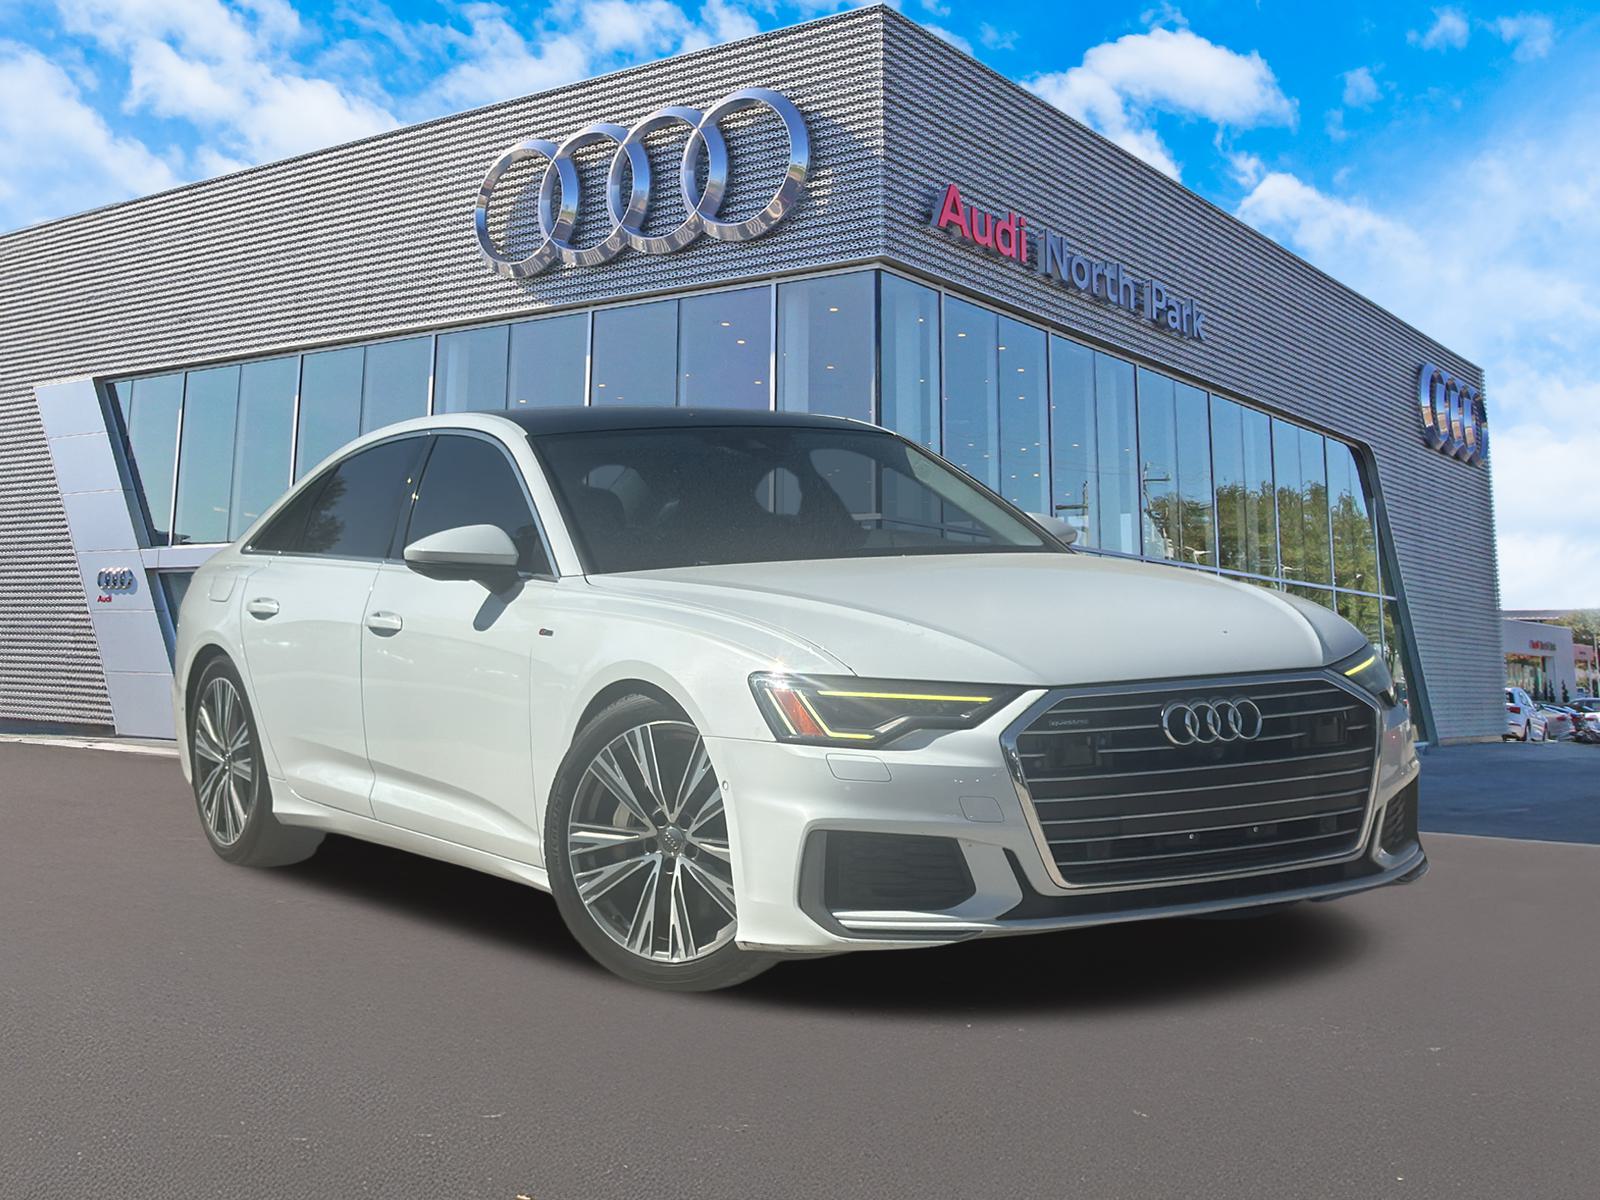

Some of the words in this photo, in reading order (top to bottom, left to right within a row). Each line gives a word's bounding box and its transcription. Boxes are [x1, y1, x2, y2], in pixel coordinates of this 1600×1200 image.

[935, 183, 1028, 264] Audi
[1040, 229, 1136, 311] North
[1146, 279, 1208, 342] Park
[97, 594, 112, 603] Audi
